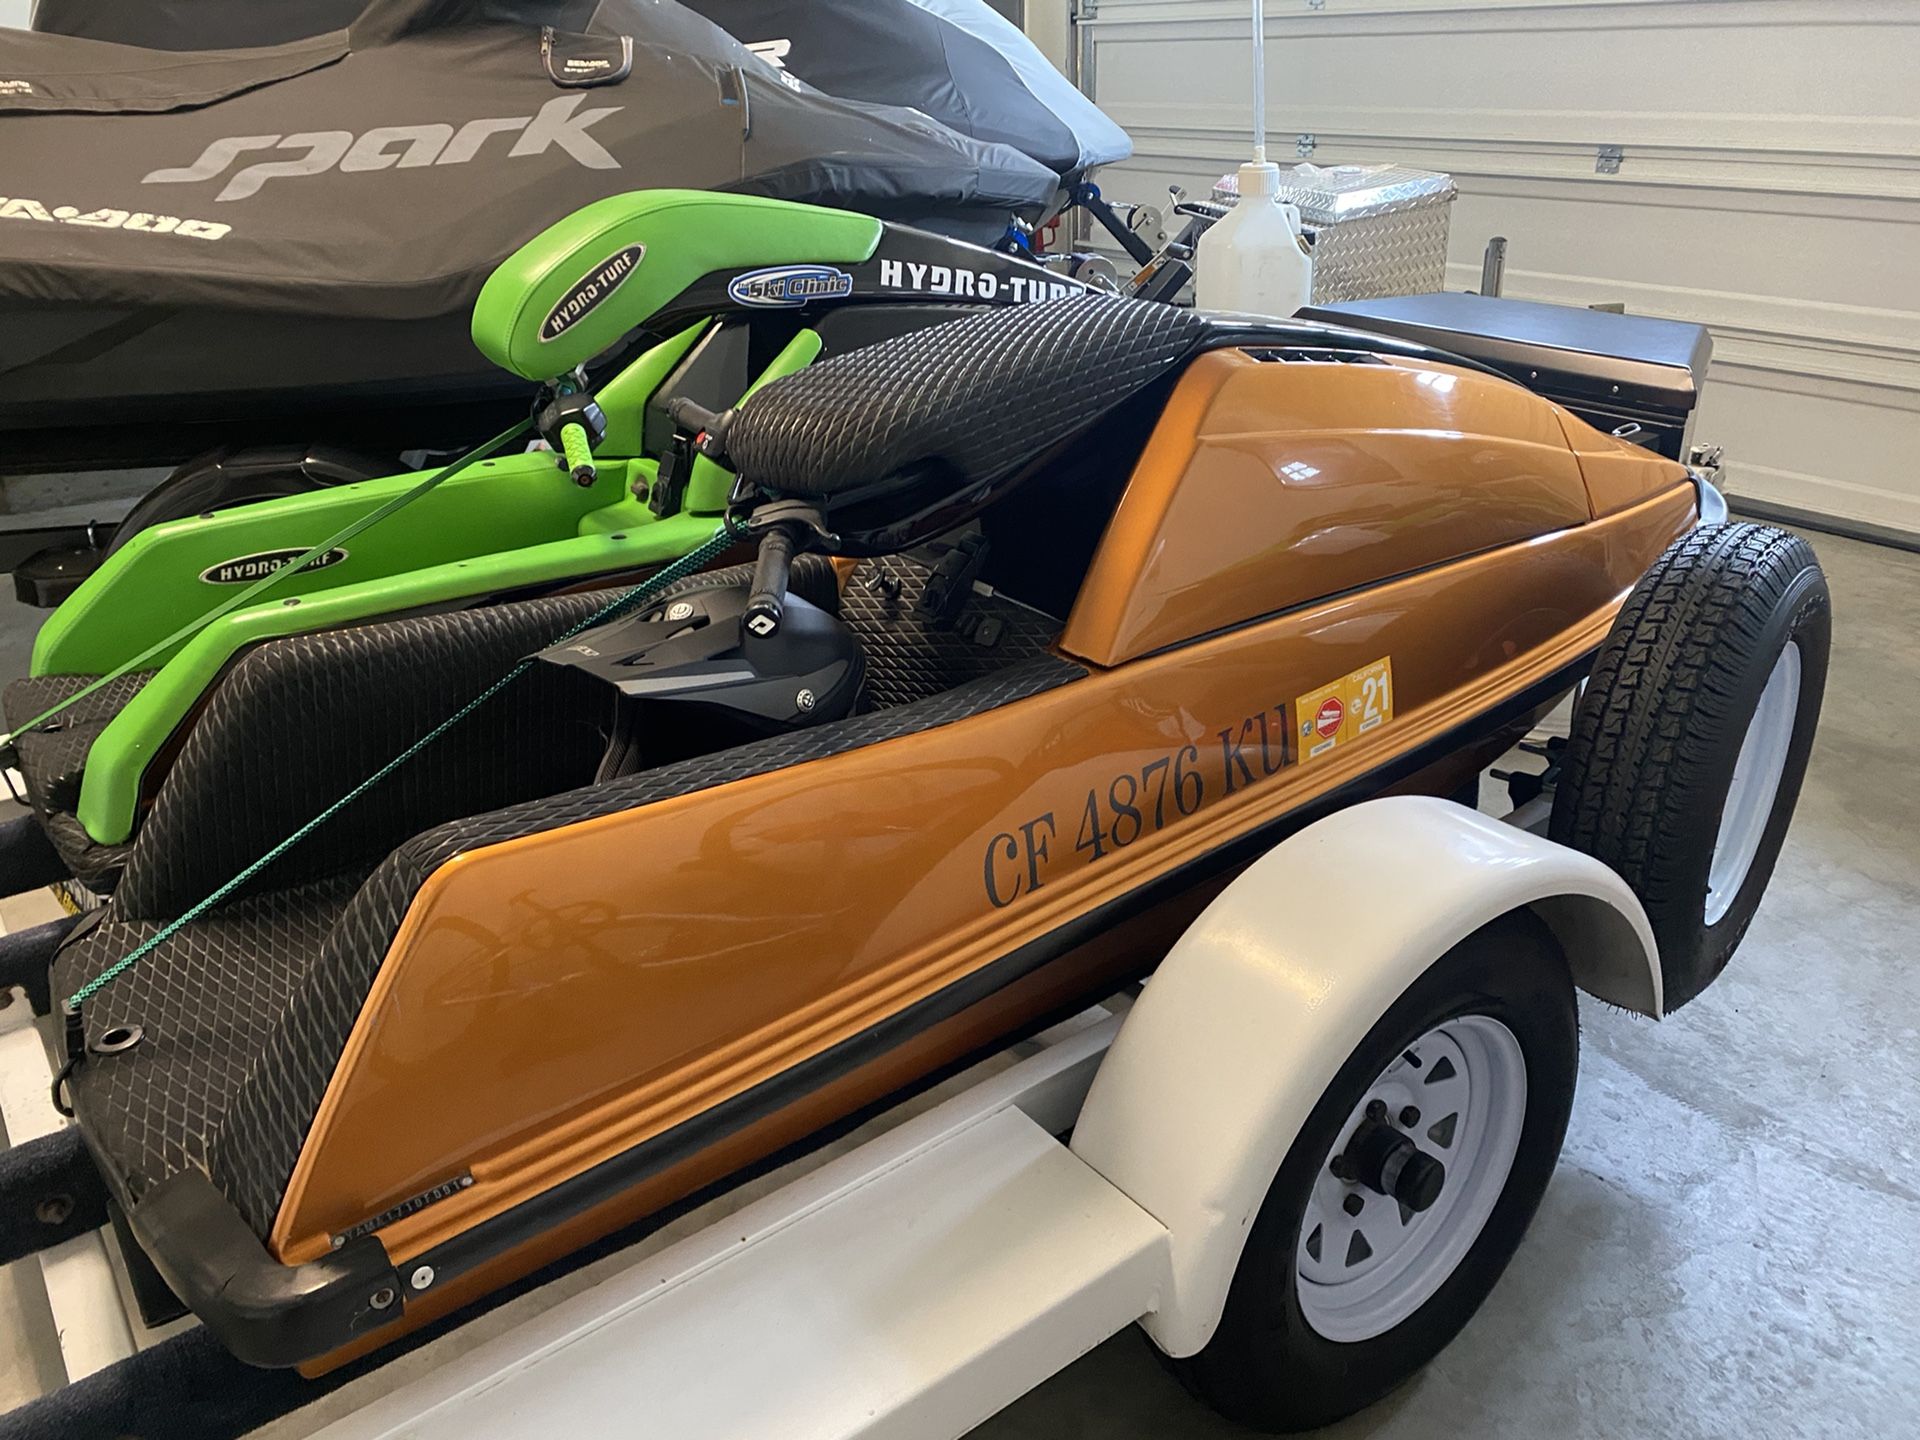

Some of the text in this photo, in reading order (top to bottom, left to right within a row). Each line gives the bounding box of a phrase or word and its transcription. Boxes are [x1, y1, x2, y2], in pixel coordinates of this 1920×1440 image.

[140, 92, 626, 202] spark
[550, 252, 633, 333] HYDRO-TURF
[748, 279, 785, 298] Ski
[788, 276, 848, 296] Clinic
[1362, 671, 1389, 721] 21
[984, 703, 1296, 909] CF 4876 KU
